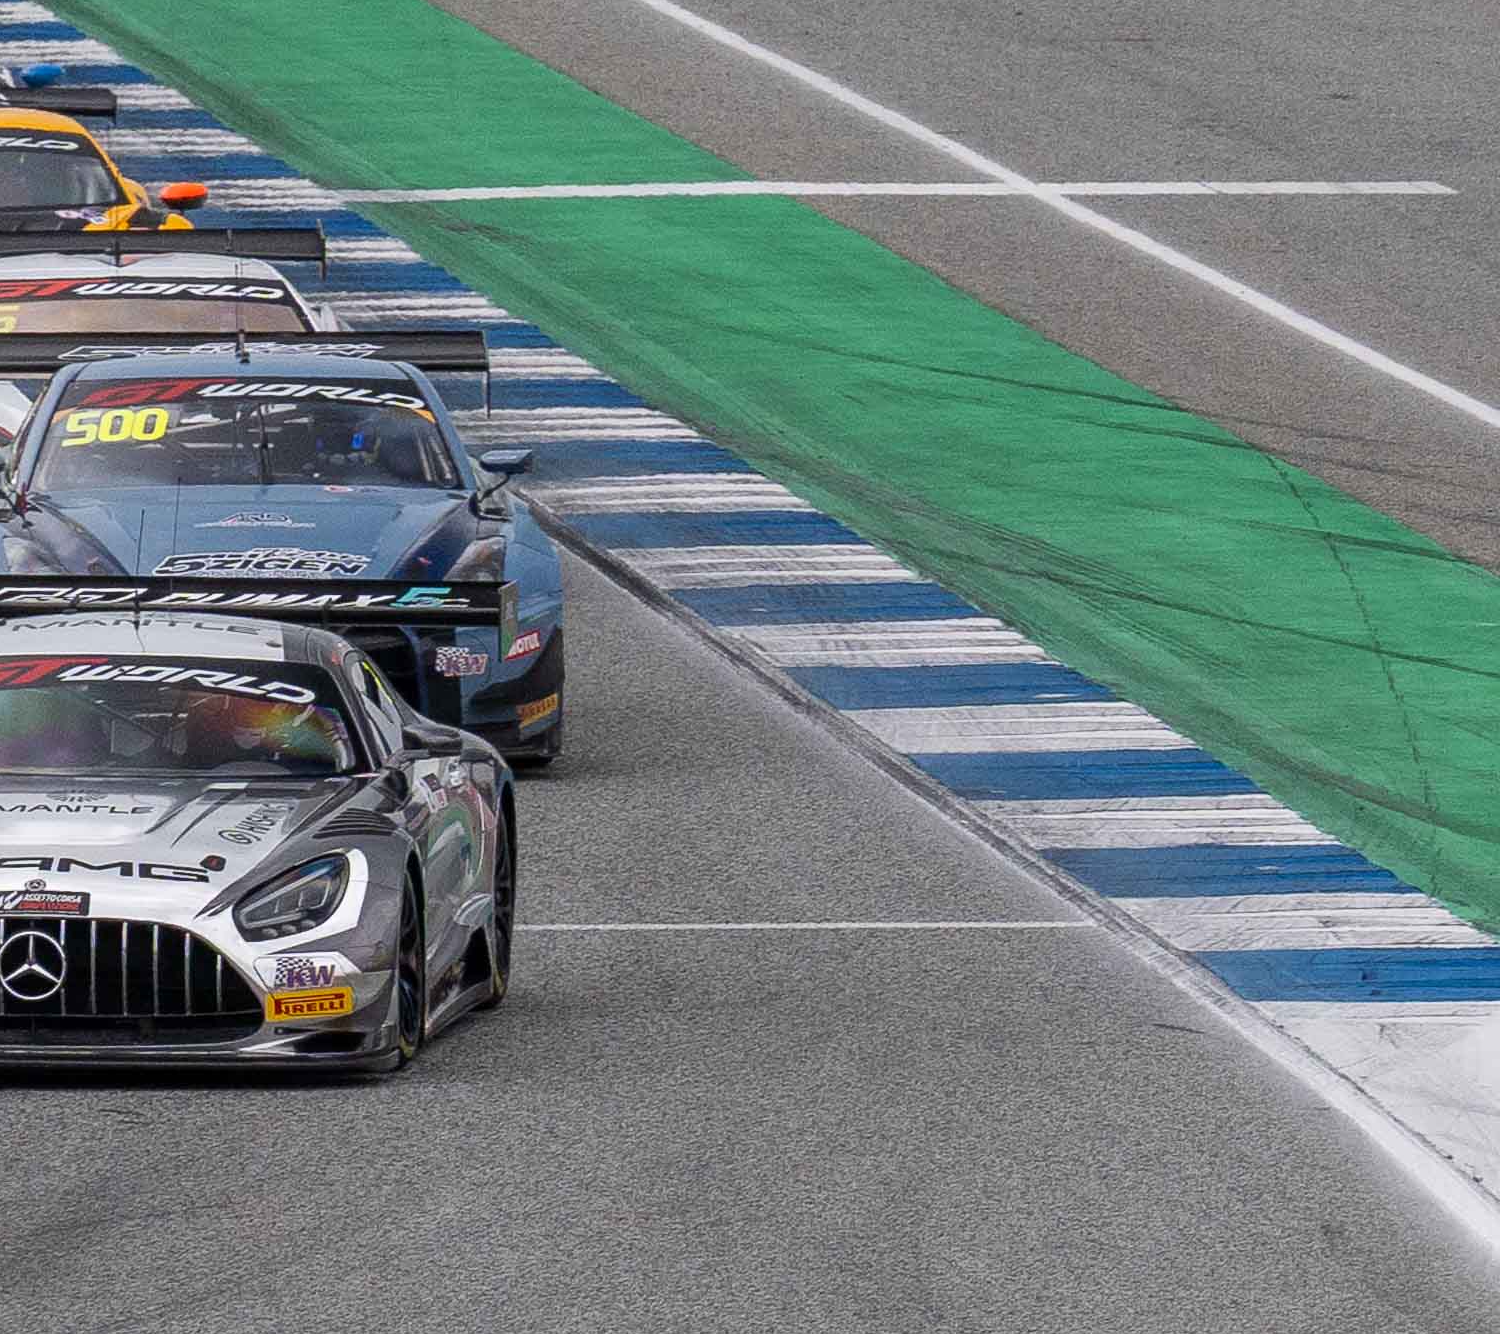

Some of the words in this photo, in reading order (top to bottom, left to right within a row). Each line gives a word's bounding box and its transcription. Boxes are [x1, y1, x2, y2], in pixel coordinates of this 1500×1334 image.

[70, 281, 286, 300] WORLD
[197, 382, 427, 410] WORLD
[60, 407, 170, 449] 500
[59, 662, 318, 705] WORLD
[274, 992, 348, 1017] PIRELLI
